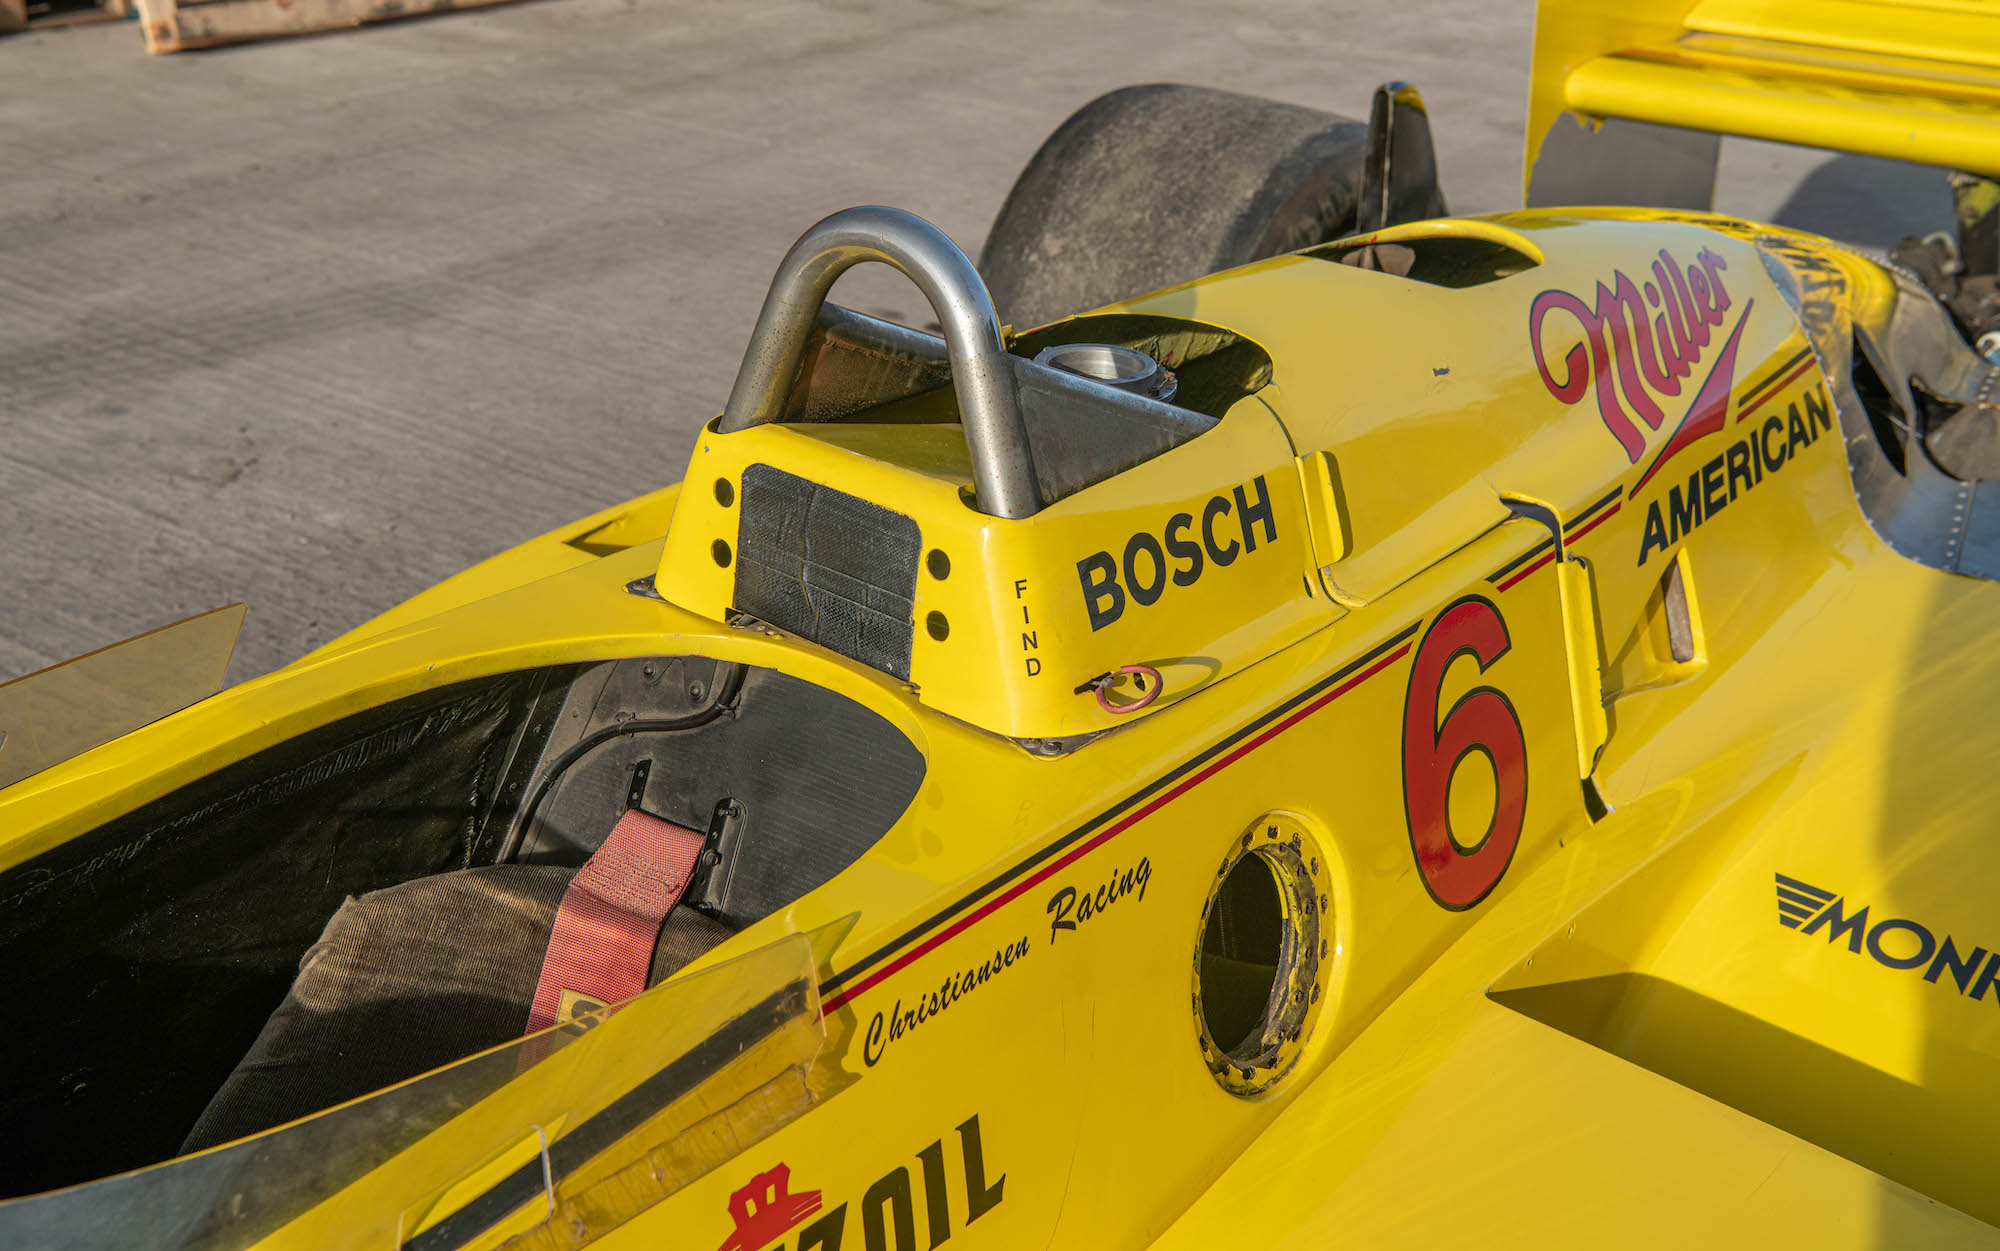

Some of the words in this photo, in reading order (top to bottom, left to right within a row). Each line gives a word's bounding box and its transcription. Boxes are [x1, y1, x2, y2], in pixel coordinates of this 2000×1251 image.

[1529, 247, 1732, 465] Miller
[1076, 475, 1278, 632] BOSCH
[1637, 383, 1832, 567] AMERICAN
[1402, 594, 1528, 912] 6
[864, 935, 1031, 1067] Christiansen
[1046, 857, 1153, 945] Racing
